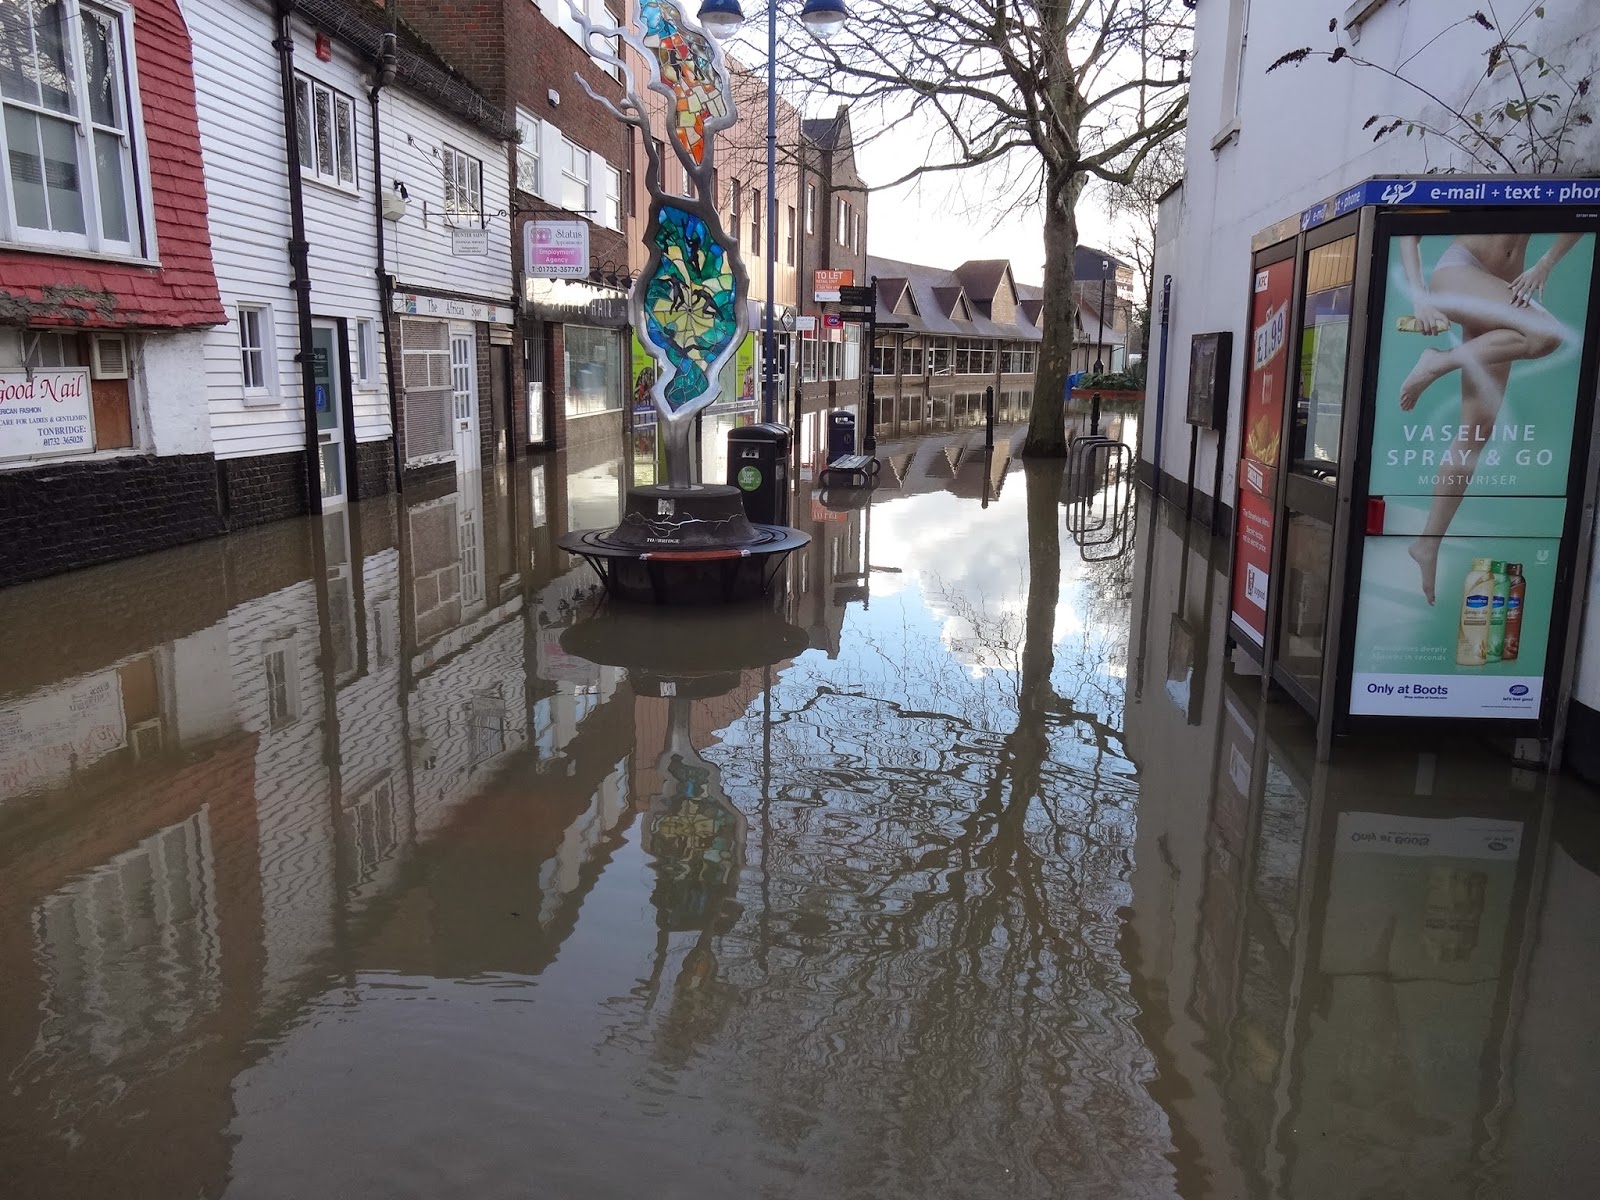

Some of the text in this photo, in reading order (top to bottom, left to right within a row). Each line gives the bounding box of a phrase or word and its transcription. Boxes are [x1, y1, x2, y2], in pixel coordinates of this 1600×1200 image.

[1430, 184, 1486, 199] e-mail
[1505, 184, 1541, 199] text
[555, 229, 582, 239] Status
[539, 248, 575, 257] Employment
[546, 256, 568, 264] Agency
[816, 271, 843, 280] TO LET
[427, 299, 438, 313] The
[446, 300, 465, 316] African
[1255, 311, 1284, 363] £1.99
[40, 374, 84, 403] Nail
[19, 406, 42, 414] FASHION
[29, 416, 48, 424] LADIES
[55, 414, 88, 423] GENTLEMEN
[1402, 424, 1536, 442] VASELINE
[43, 436, 84, 447] 01732 365028
[1386, 449, 1553, 466] SPRAY & GO
[1418, 475, 1517, 485] MOISTURISER
[1420, 645, 1447, 654] deeply
[1367, 683, 1448, 695] Only at Boots
